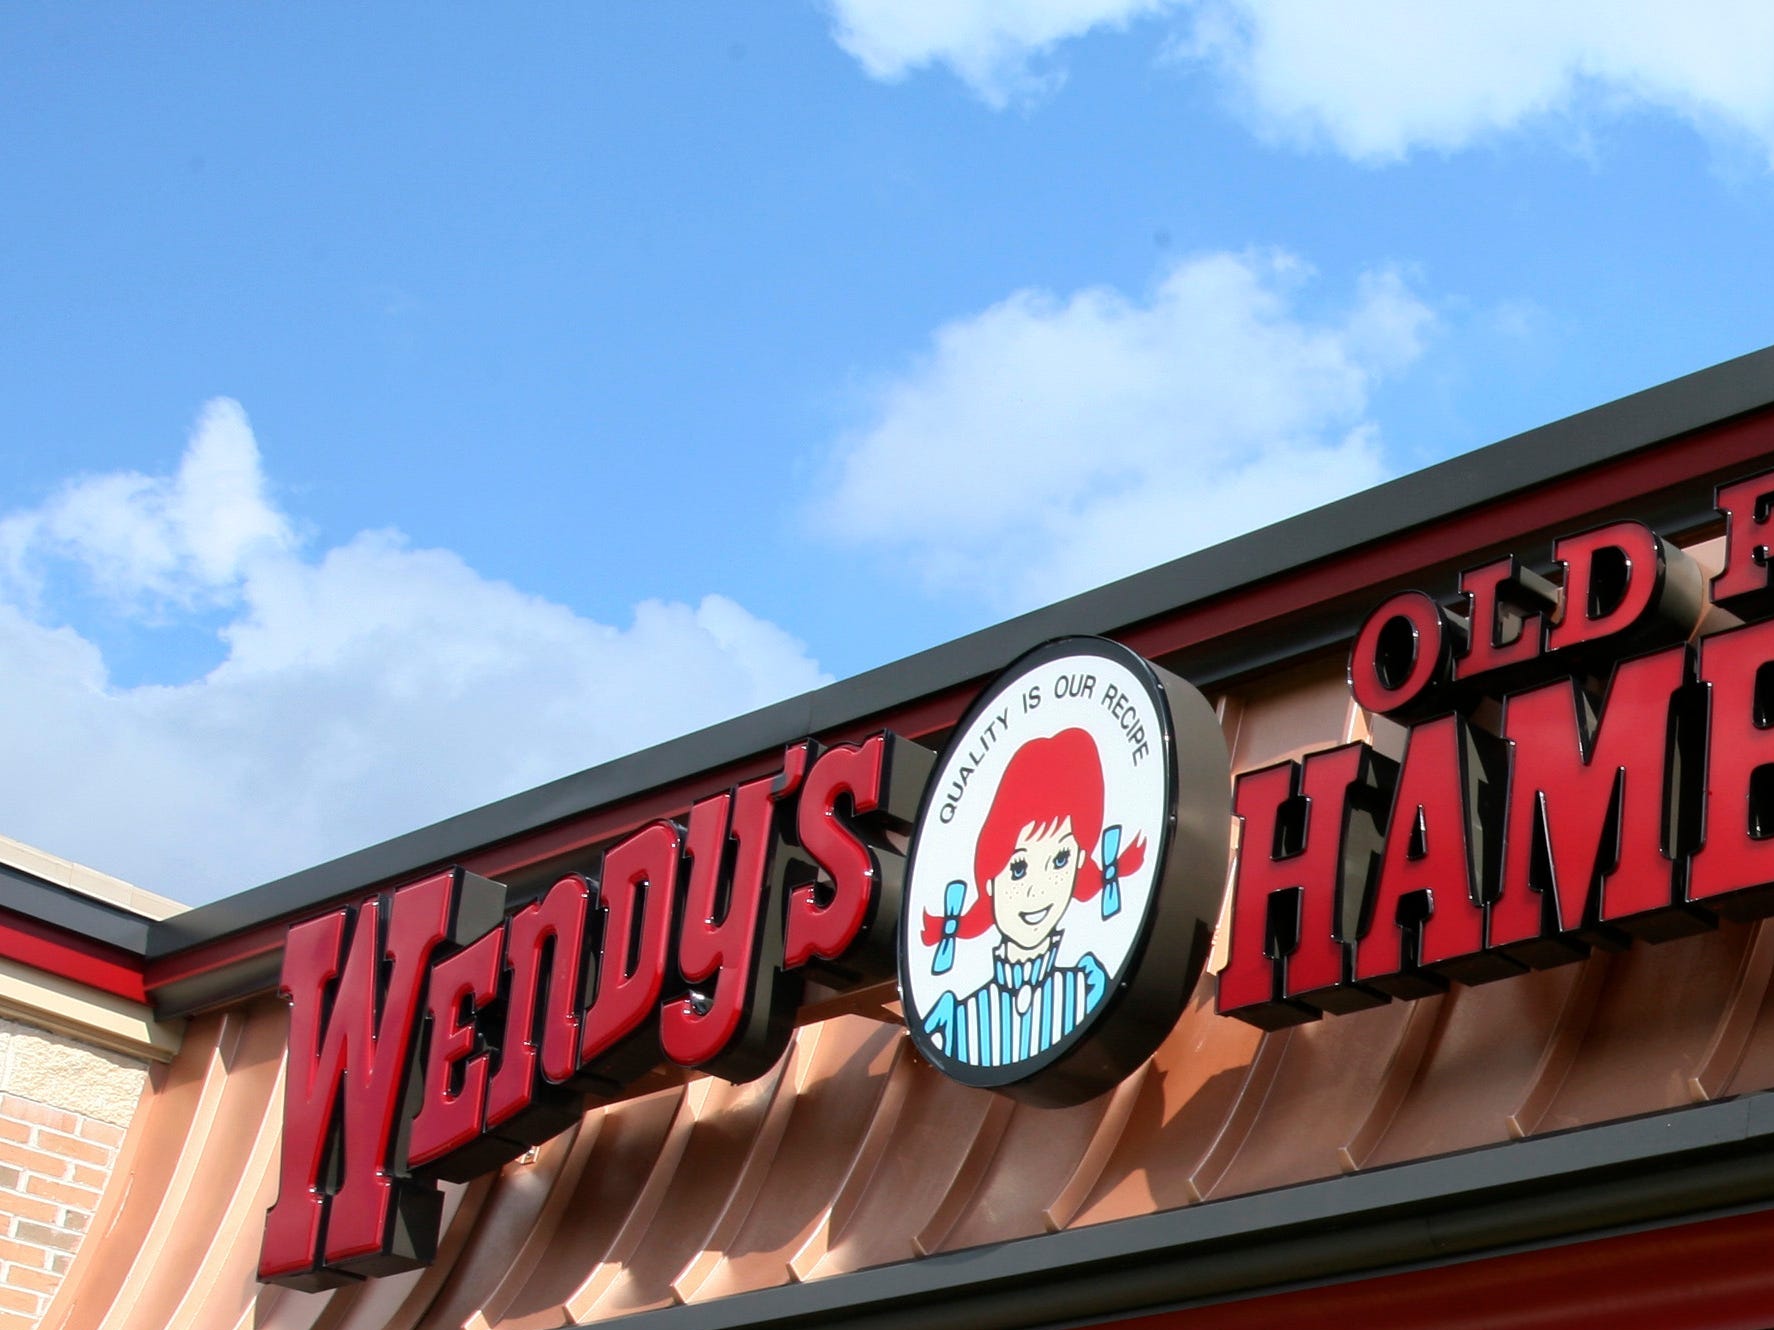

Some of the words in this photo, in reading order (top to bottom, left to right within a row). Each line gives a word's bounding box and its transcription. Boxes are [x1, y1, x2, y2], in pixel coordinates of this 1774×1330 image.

[1347, 517, 1668, 715] OLD
[940, 708, 1010, 824] QUALITY
[1021, 685, 1042, 715] IS
[1053, 673, 1097, 700] OUR
[1101, 683, 1150, 767] RECIPE
